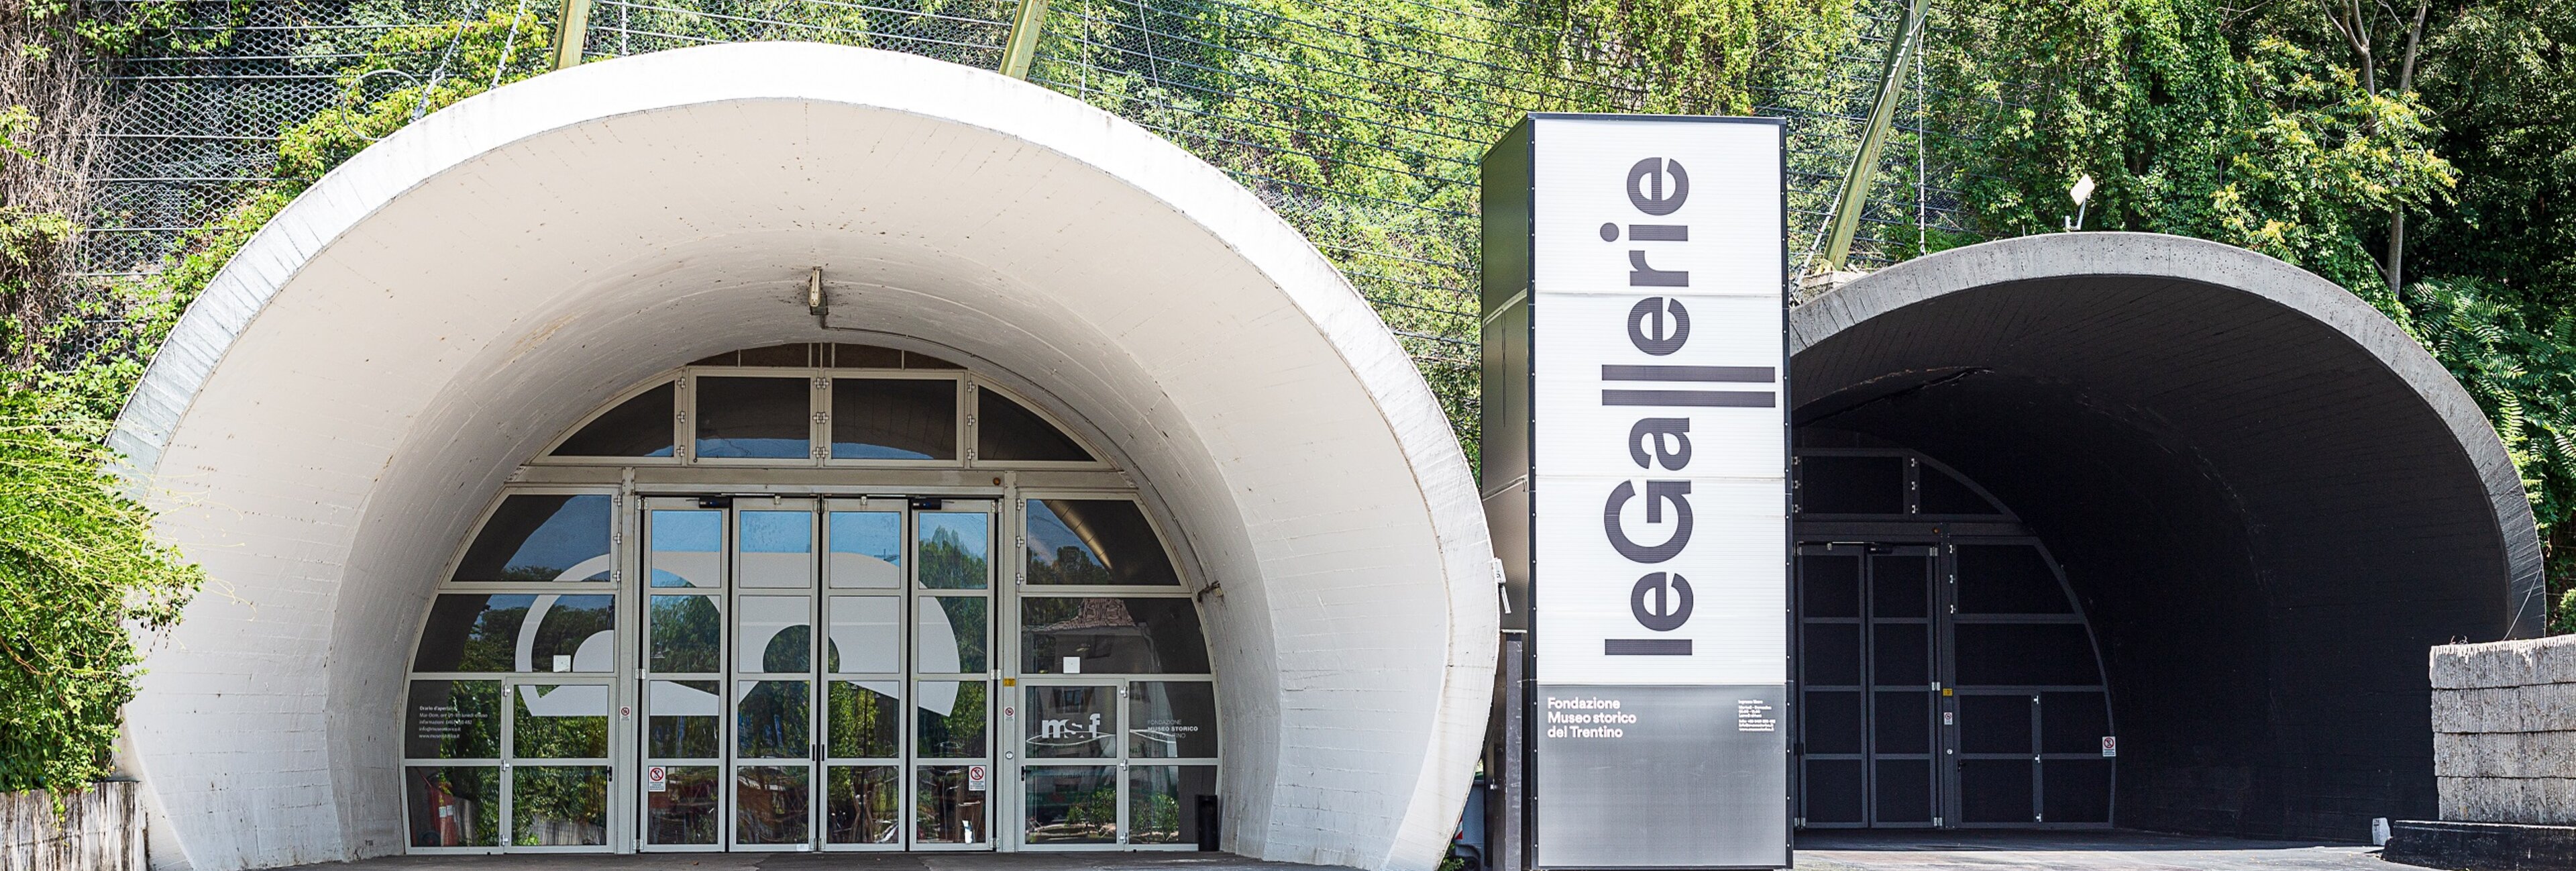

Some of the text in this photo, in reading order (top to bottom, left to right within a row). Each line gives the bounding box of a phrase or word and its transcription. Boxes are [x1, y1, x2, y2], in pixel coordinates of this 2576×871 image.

[1600, 156, 1776, 656] leGallerie
[1548, 697, 1621, 709] Fondazione
[1548, 711, 1637, 723] Museo storico
[1548, 725, 1623, 738] del Trentino
